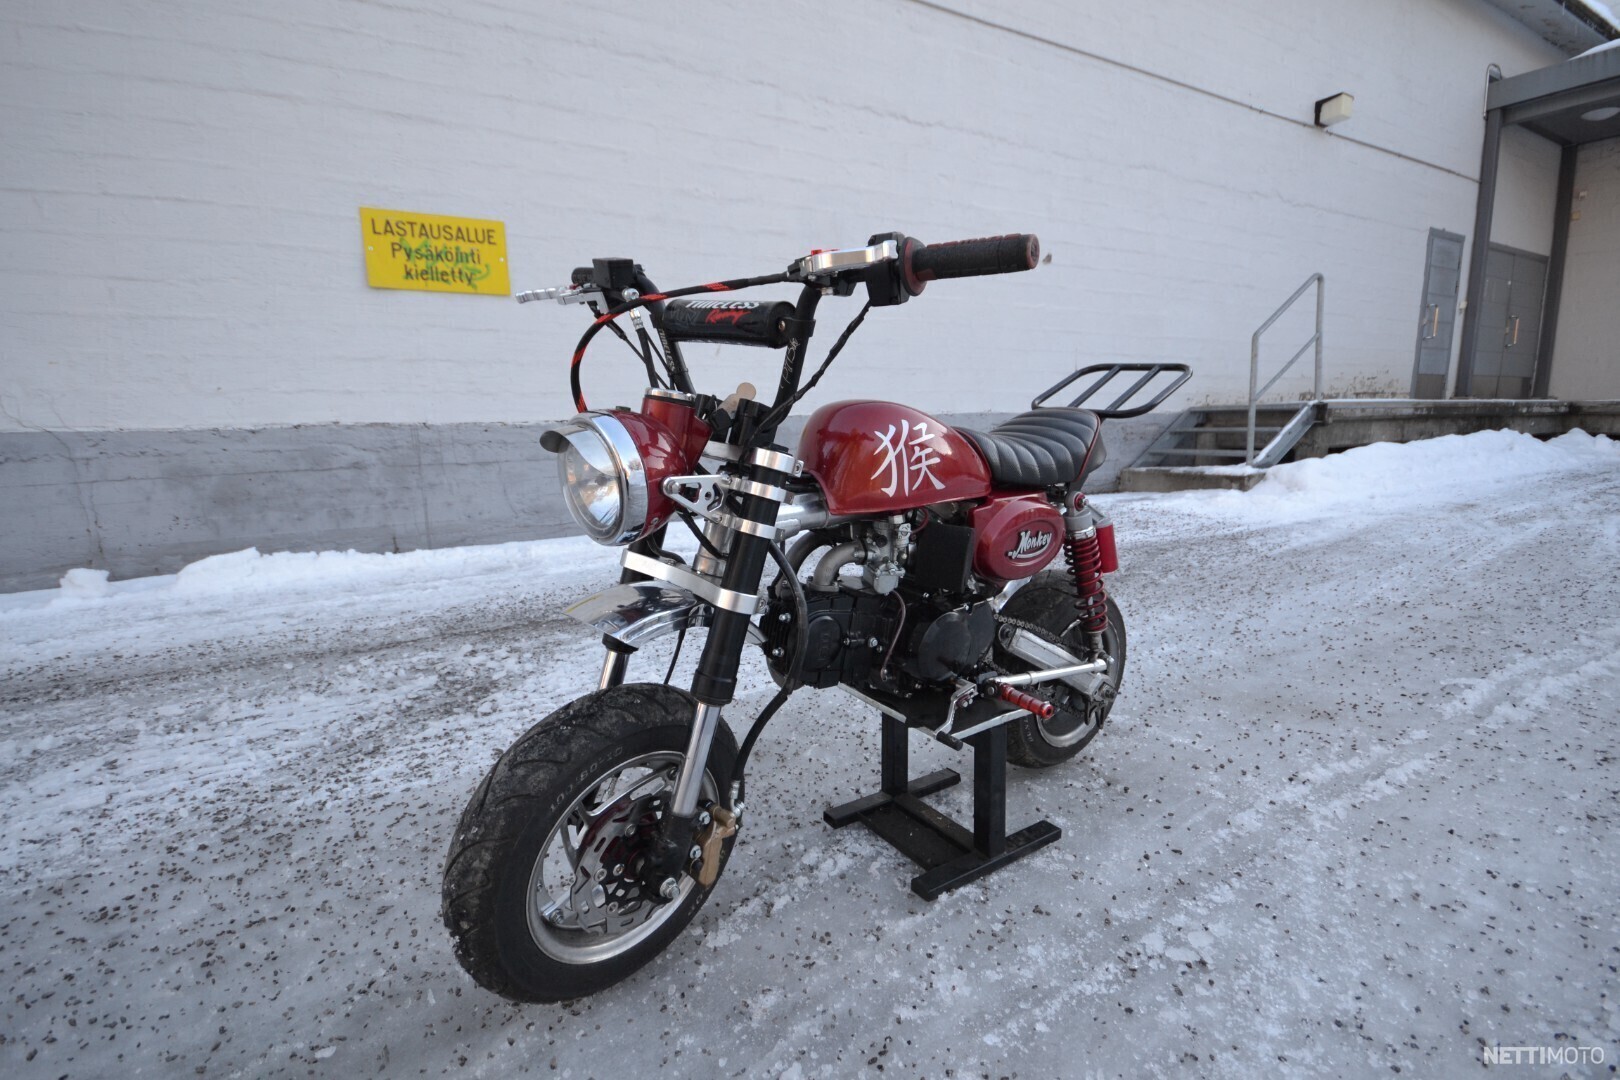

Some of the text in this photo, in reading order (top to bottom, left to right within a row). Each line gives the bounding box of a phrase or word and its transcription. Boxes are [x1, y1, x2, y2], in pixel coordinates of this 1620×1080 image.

[371, 218, 497, 246] LASTAUSALUE
[391, 242, 481, 265] Pysäköinti
[404, 264, 474, 286] kielletty
[870, 419, 946, 498] 猴
[1007, 530, 1053, 560] Monkey
